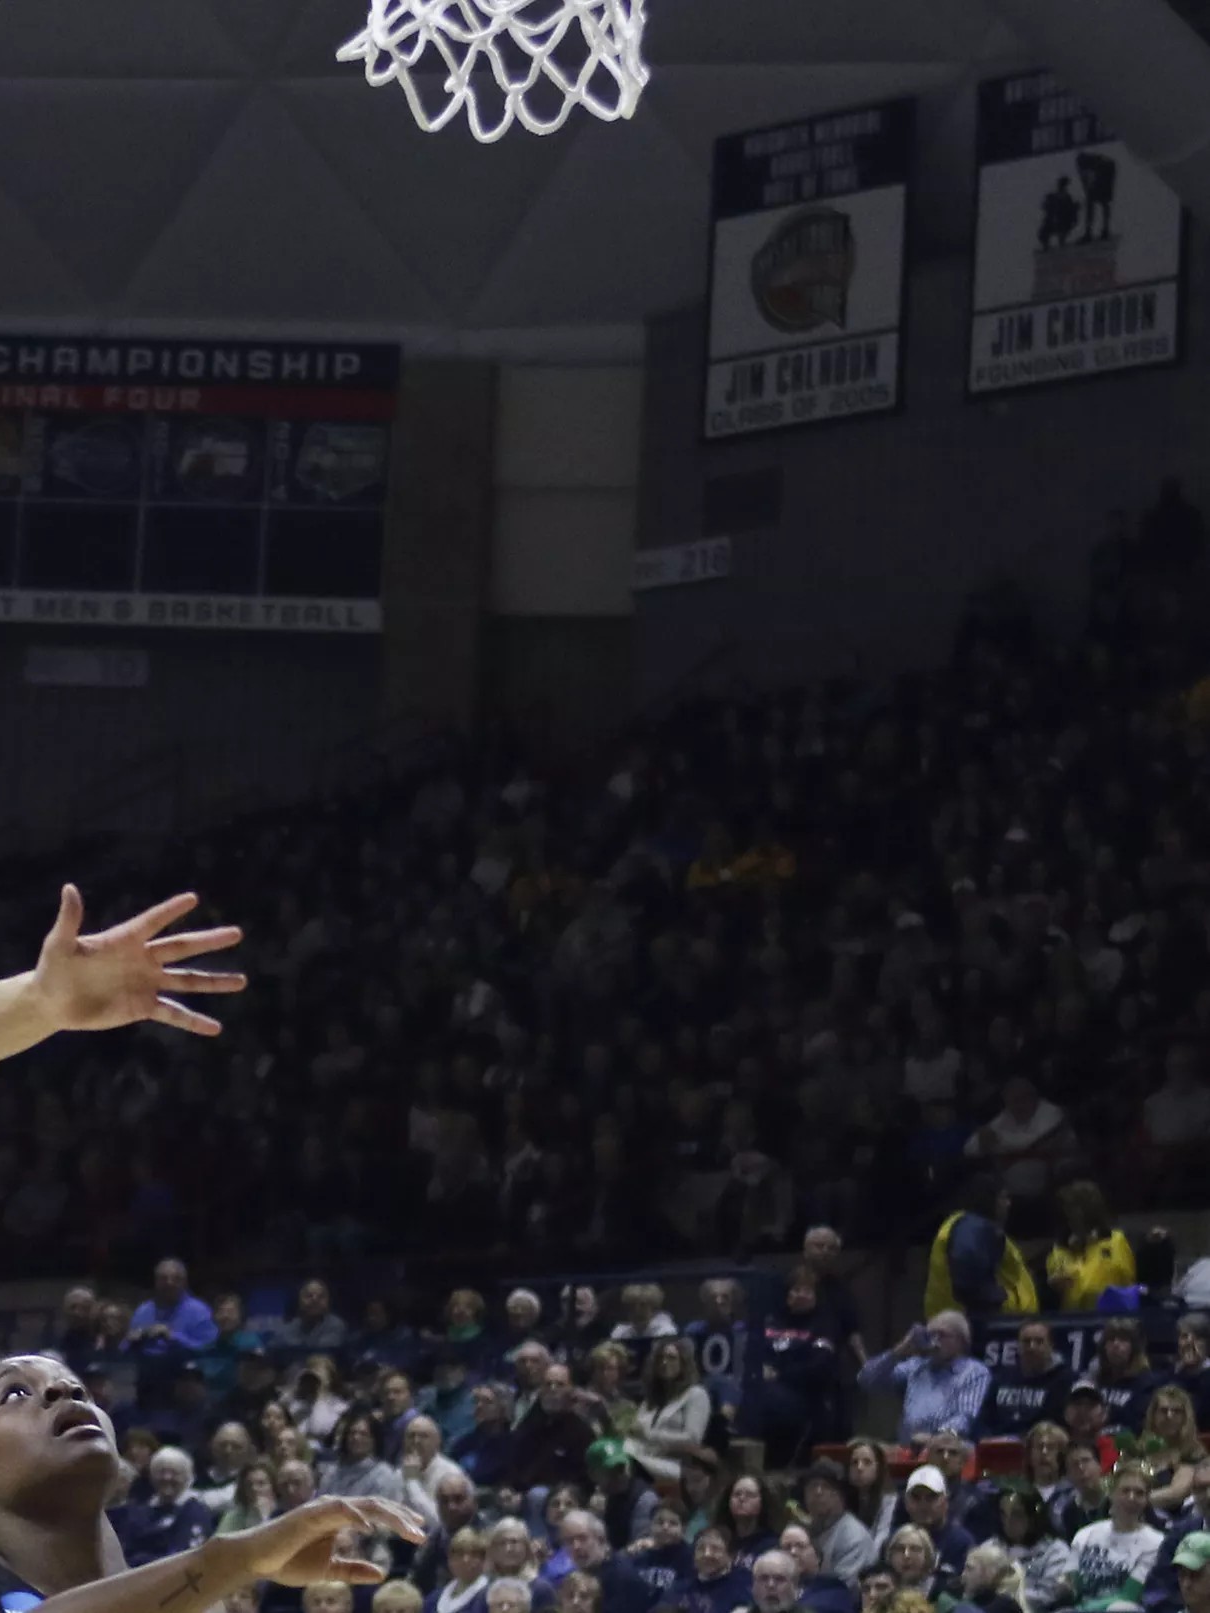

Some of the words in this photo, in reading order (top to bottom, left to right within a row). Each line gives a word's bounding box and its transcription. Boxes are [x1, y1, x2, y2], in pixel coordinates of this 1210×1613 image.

[990, 312, 1034, 357] JIM
[102, 384, 202, 411] FOUR
[148, 600, 364, 628] BASKETBALL
[984, 1340, 1019, 1368] SE
